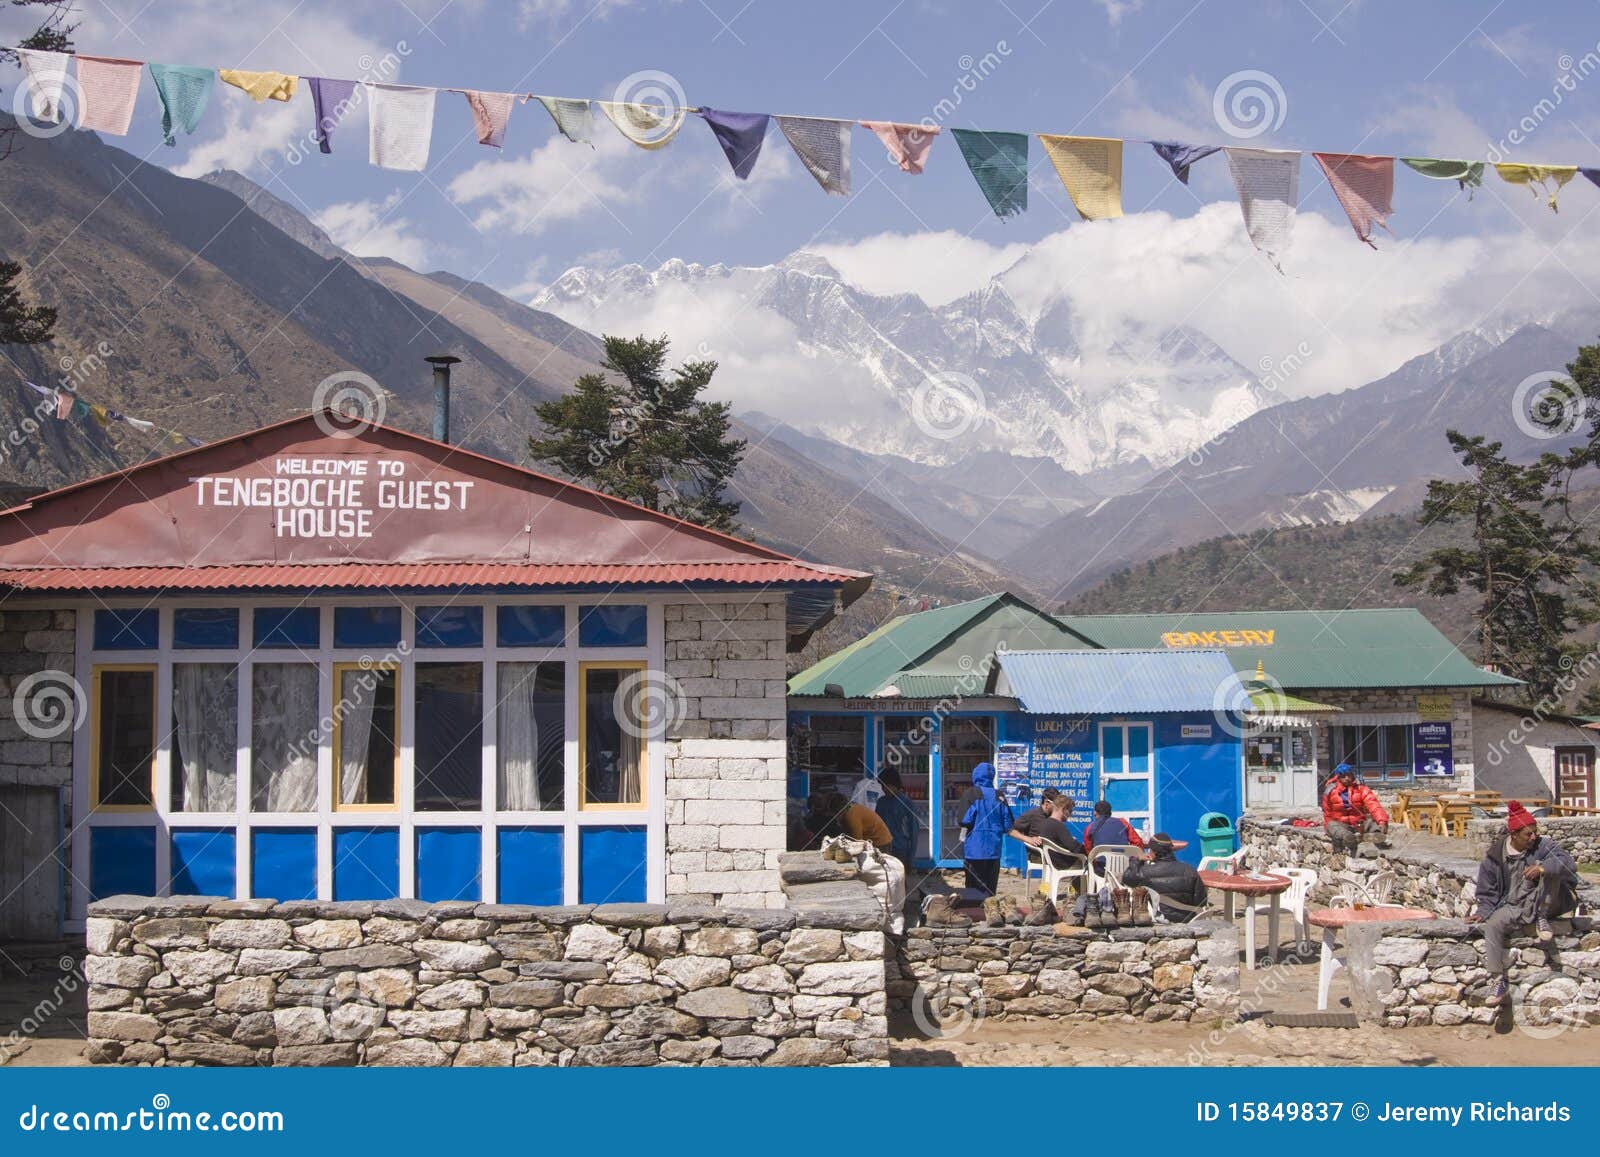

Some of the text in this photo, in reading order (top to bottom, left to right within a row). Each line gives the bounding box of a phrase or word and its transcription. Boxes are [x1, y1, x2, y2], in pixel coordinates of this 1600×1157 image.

[276, 459, 405, 476] WELCOME TO
[190, 477, 474, 510] TENGBOCHE GUEST
[277, 508, 373, 537] HOUSE
[1161, 629, 1275, 648] BAKERY
[893, 700, 907, 711] MY
[1035, 719, 1091, 732] LUNCH SPOT
[1078, 789, 1088, 797] PIE
